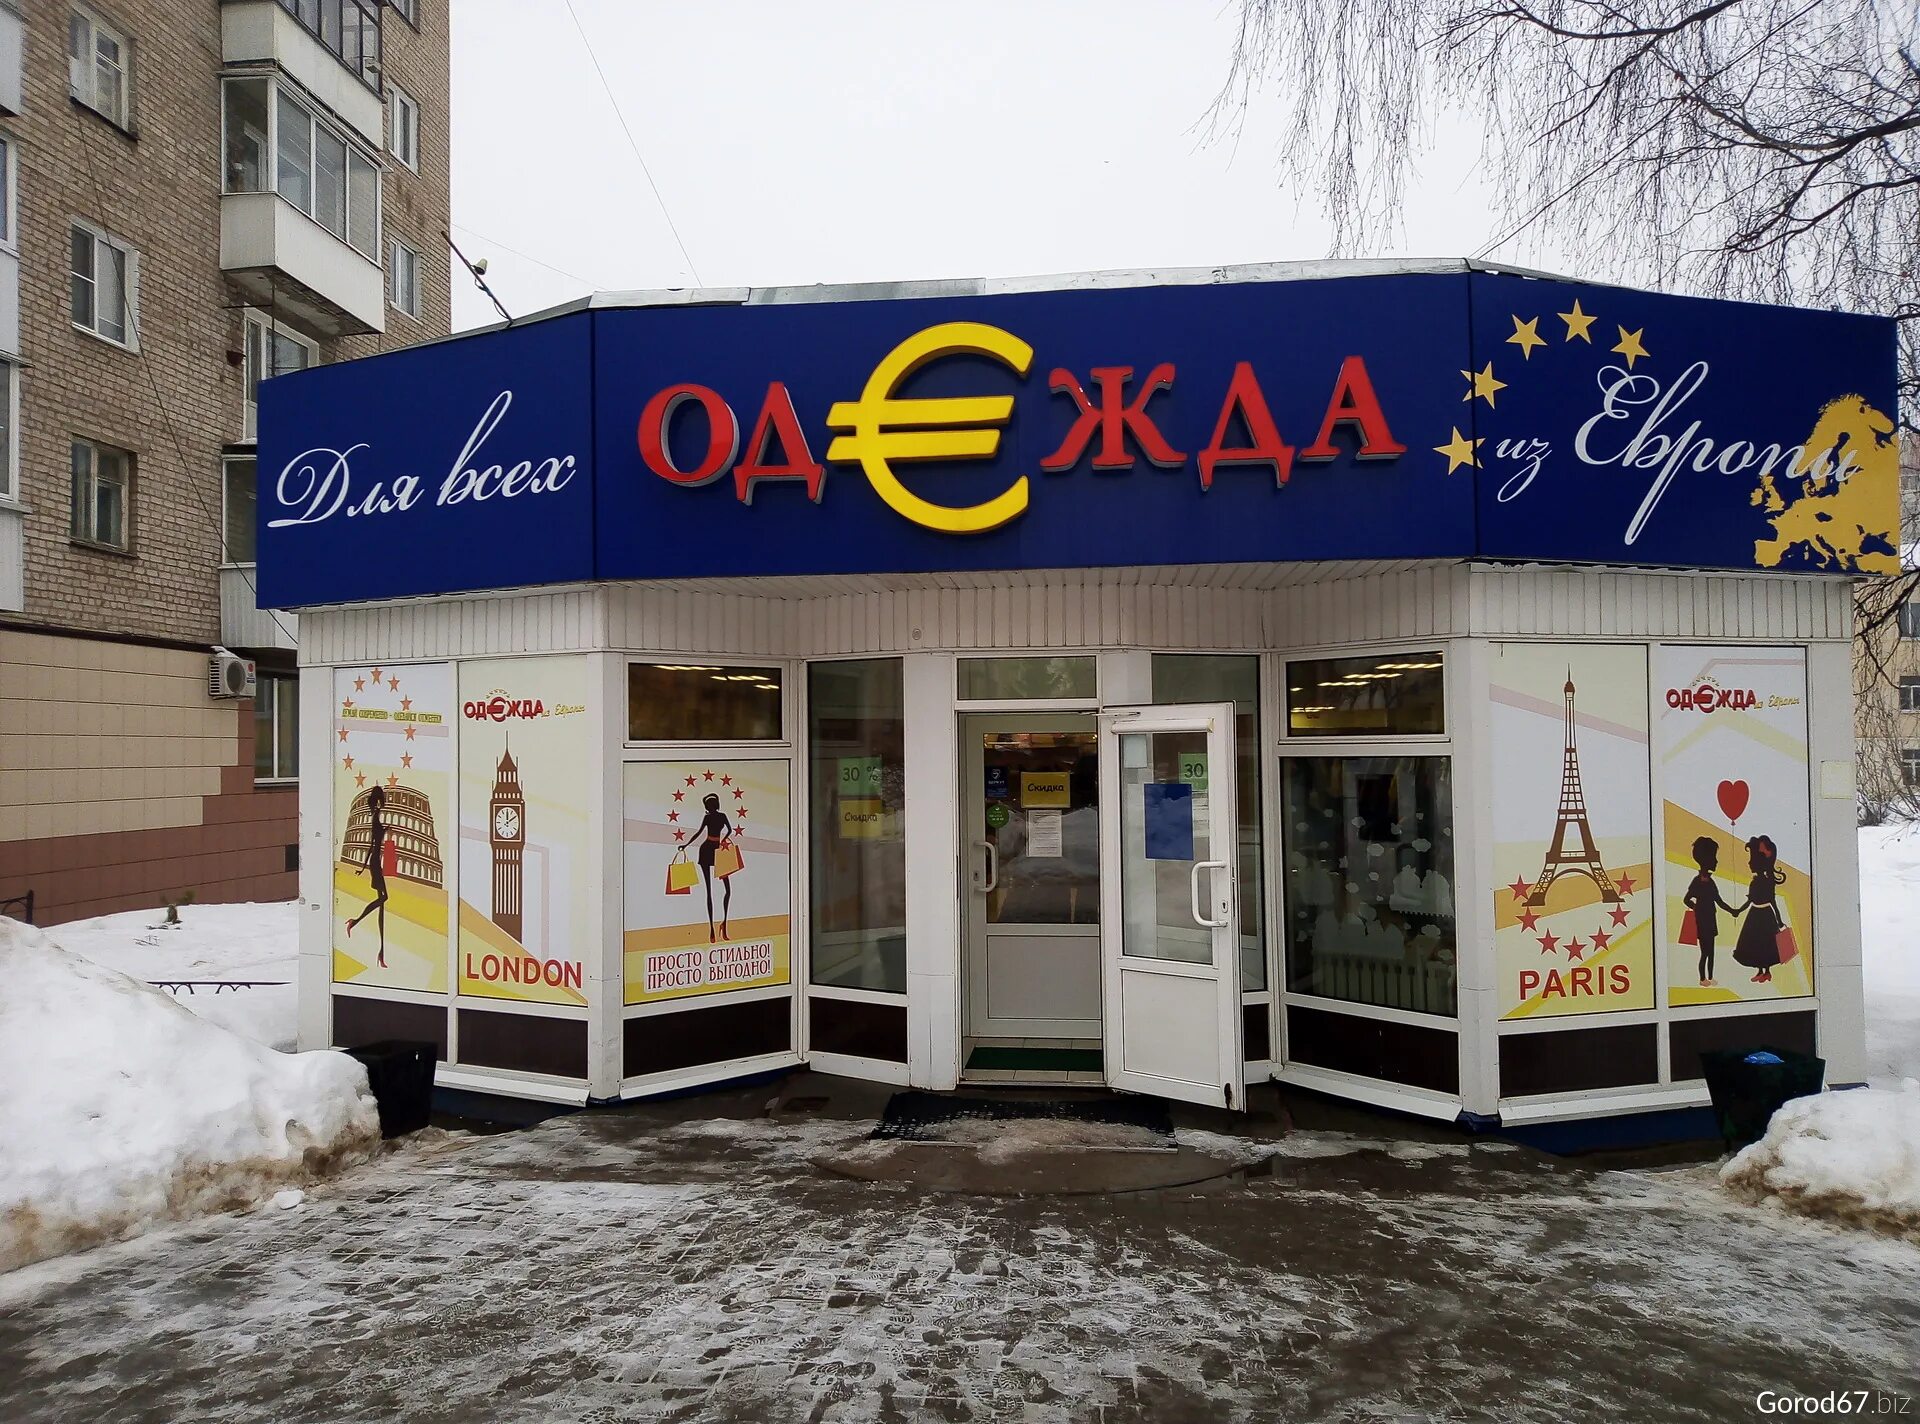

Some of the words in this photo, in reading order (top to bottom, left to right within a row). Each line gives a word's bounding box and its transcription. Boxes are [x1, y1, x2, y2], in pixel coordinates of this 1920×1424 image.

[266, 442, 425, 529] Для
[435, 389, 577, 508] всех
[1495, 436, 1553, 502] из
[1574, 360, 1862, 546] Европы
[842, 766, 861, 782] 30
[1184, 762, 1204, 778] 30
[1027, 783, 1065, 793] Скидка
[844, 811, 878, 823] Скидка
[465, 952, 583, 989] LONDON
[647, 951, 702, 973] ПРОСТО
[708, 943, 771, 965] СТИЛЬНО!
[647, 968, 702, 990] ПРОСТО
[708, 959, 771, 982] ВЫГОДНО!
[1518, 964, 1631, 1001] PARIS
